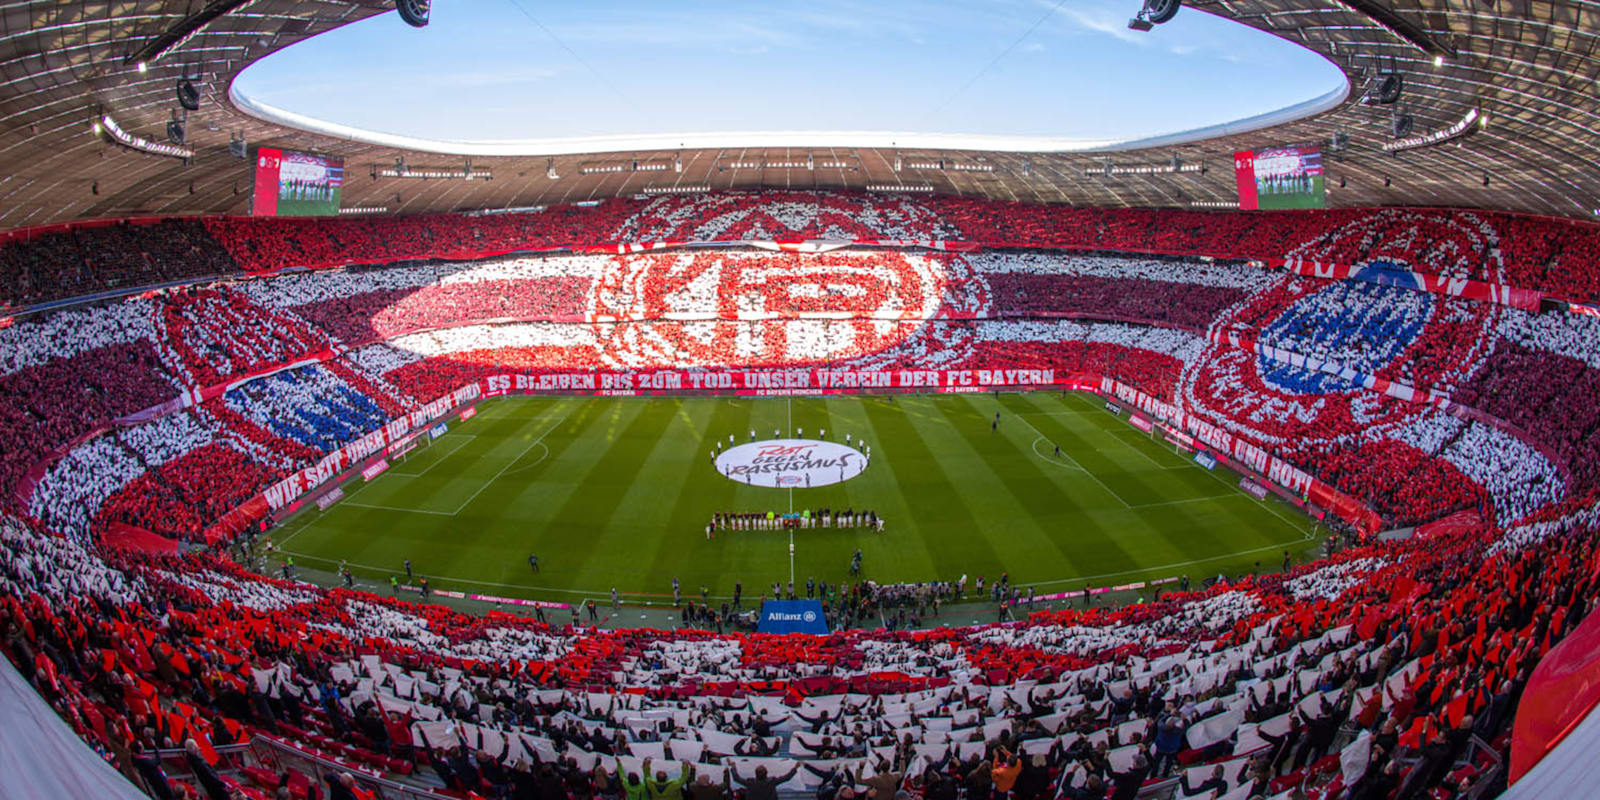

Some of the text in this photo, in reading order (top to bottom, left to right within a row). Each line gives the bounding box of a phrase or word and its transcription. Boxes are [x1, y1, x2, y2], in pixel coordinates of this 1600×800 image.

[487, 375, 511, 391] ES
[515, 374, 595, 390] BLEIBEN
[600, 374, 633, 389] BIS
[638, 372, 681, 388] ZUM
[744, 371, 810, 388] UNSER
[816, 371, 892, 388] VEREIN
[900, 370, 939, 387] DER
[946, 369, 973, 386] FC
[978, 369, 1055, 386] BAYERN
[1101, 377, 1113, 394] IN
[1116, 382, 1137, 405] DEN
[1137, 390, 1183, 430] FARBEN
[1187, 413, 1232, 454] WEISS
[1235, 438, 1268, 473] UND
[1268, 456, 1314, 496] ROT!
[263, 473, 303, 512] WIE
[305, 449, 342, 490] SEIT
[386, 415, 409, 443] 100
[410, 395, 452, 428] JAHREN
[752, 450, 813, 464] GEGEN
[758, 444, 819, 456] ROT
[730, 453, 855, 475] RASSISMUS
[768, 612, 802, 621] Allianz
